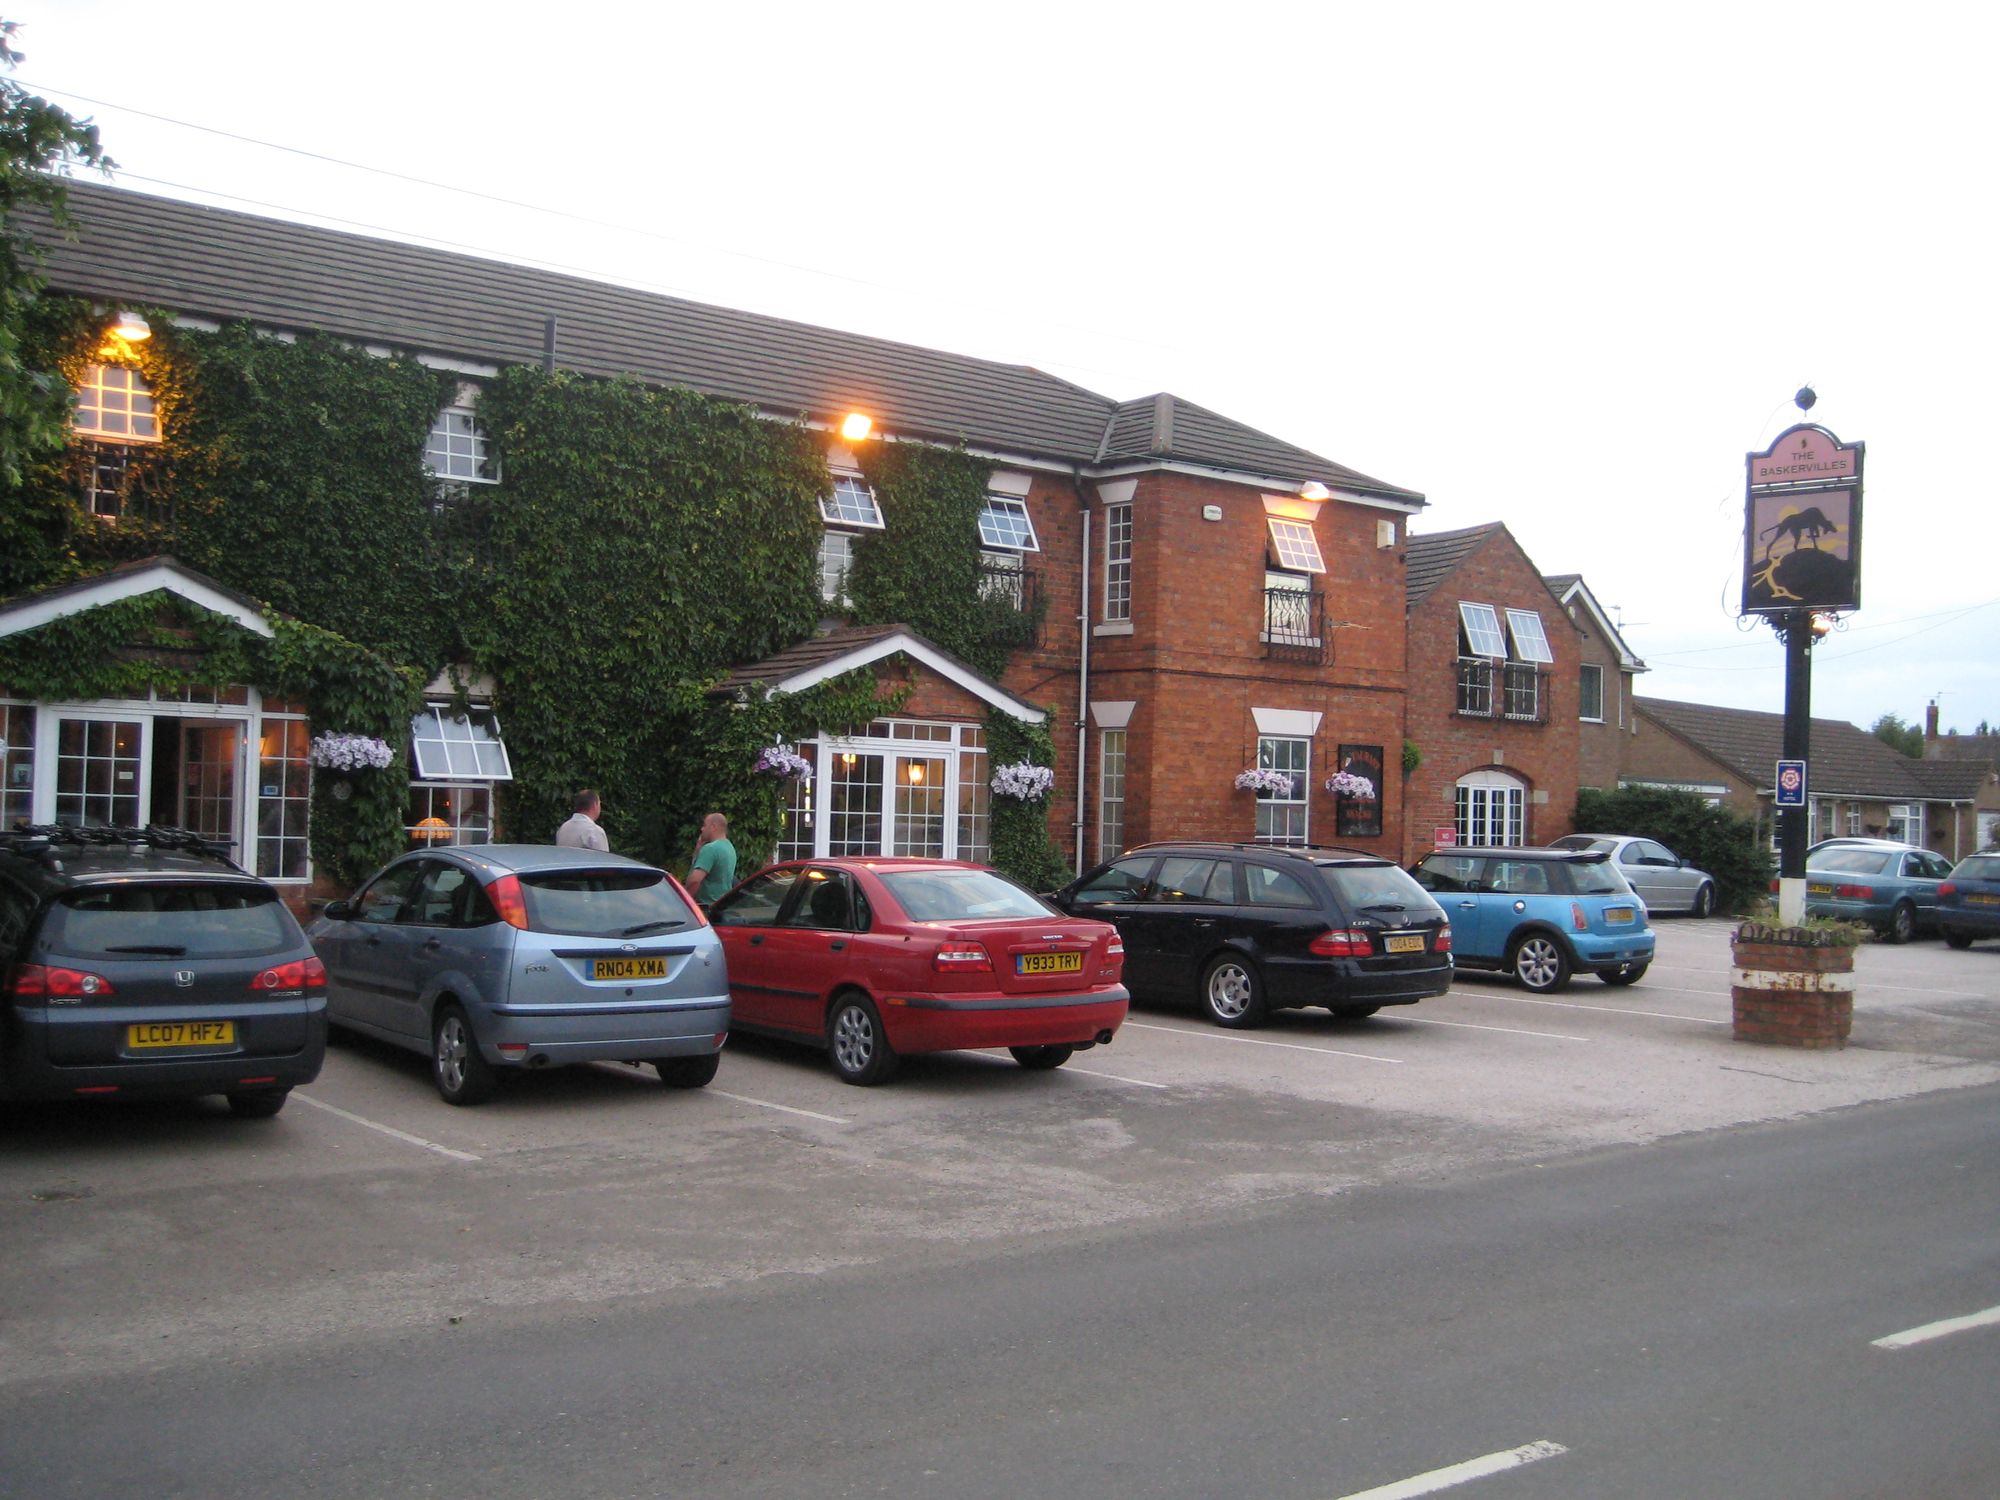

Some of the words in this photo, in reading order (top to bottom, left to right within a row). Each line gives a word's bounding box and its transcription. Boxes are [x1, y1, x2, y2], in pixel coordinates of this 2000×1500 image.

[1792, 451, 1815, 461] THE
[1760, 460, 1847, 476] BASKERVILLES
[596, 961, 634, 977] RN04
[638, 959, 665, 975] XMA
[1025, 956, 1055, 970] Y933
[1057, 954, 1079, 968] TRY
[136, 1025, 184, 1043] LC07
[190, 1023, 225, 1041] HFZ
